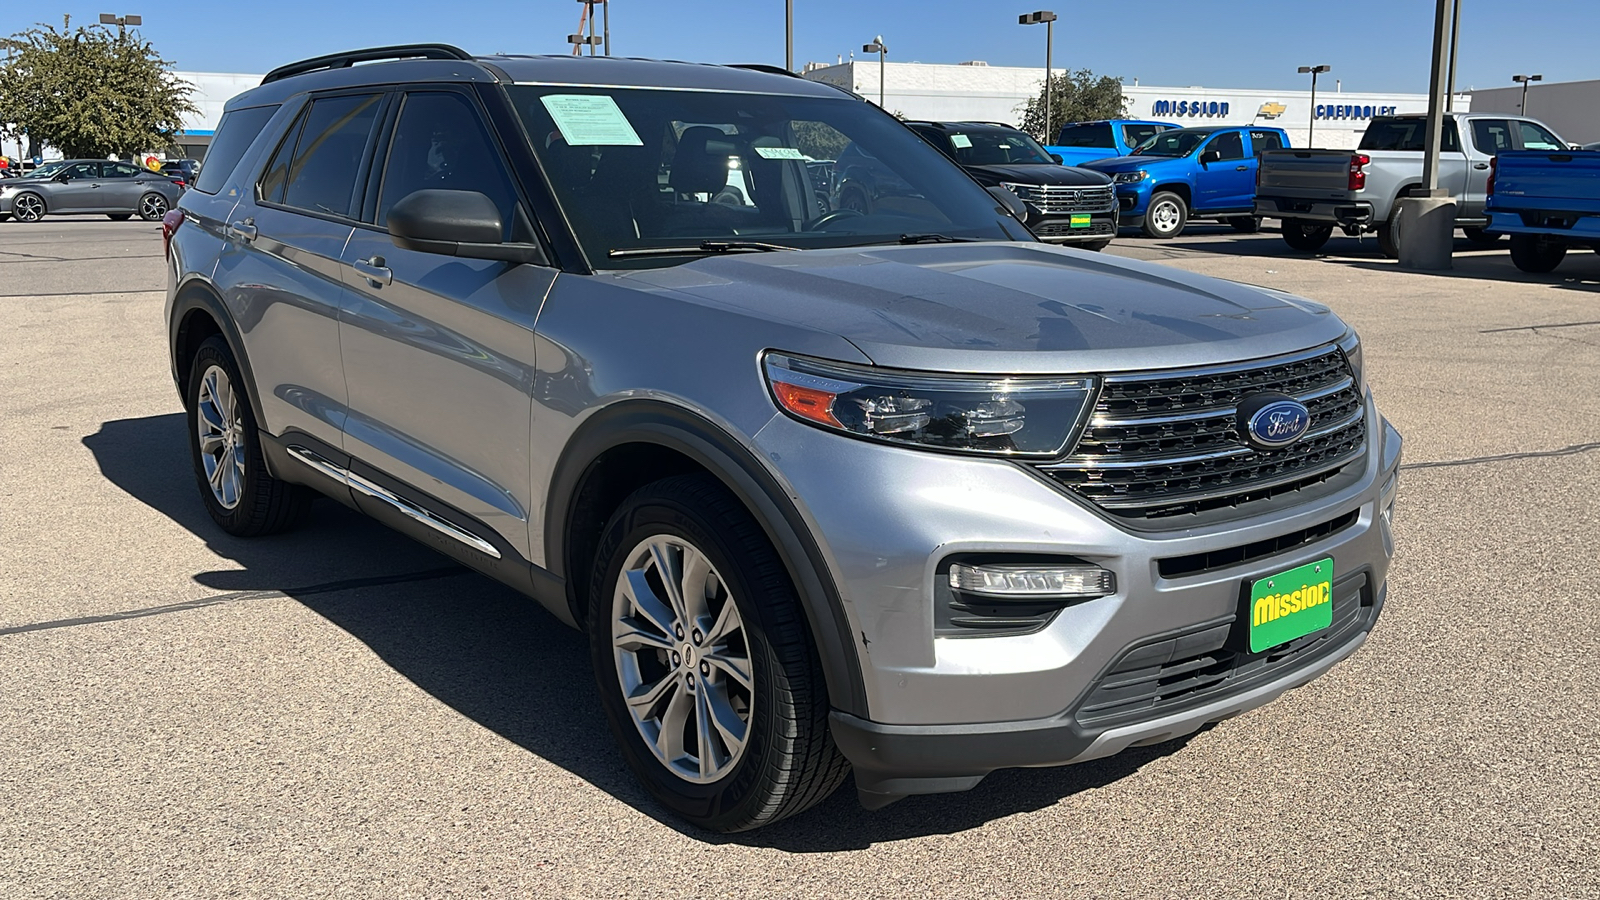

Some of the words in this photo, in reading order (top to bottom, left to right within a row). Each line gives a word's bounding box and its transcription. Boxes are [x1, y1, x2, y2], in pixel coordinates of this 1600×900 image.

[1153, 100, 1229, 117] MISSION
[1313, 104, 1396, 120] CHEVROLET
[1268, 410, 1300, 437] Ford
[1253, 581, 1330, 627] Mission
